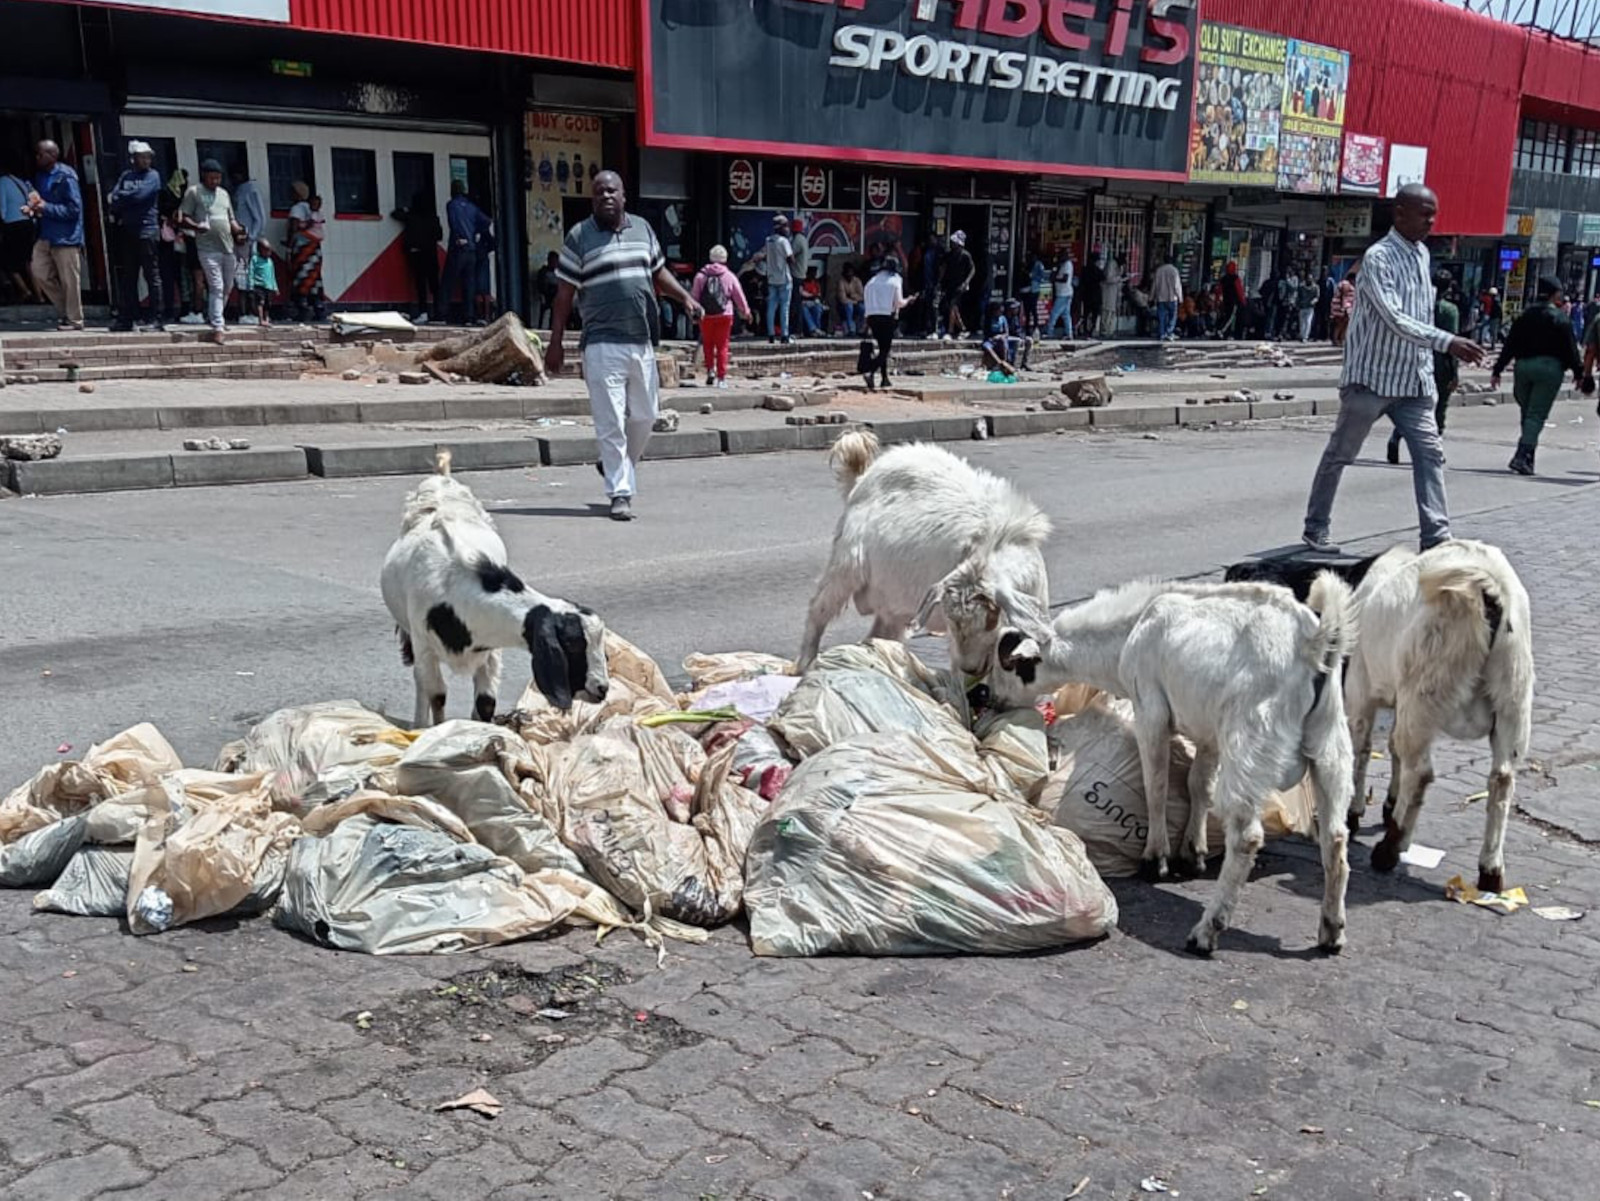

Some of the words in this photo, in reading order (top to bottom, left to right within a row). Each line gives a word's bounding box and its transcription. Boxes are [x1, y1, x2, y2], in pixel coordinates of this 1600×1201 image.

[1220, 27, 1242, 54] SUIT
[1242, 32, 1287, 62] EXCHANGE
[532, 112, 560, 129] BUY
[564, 115, 600, 132] GOLD
[729, 171, 751, 190] SB
[802, 175, 825, 194] SB
[868, 179, 890, 197] SB
